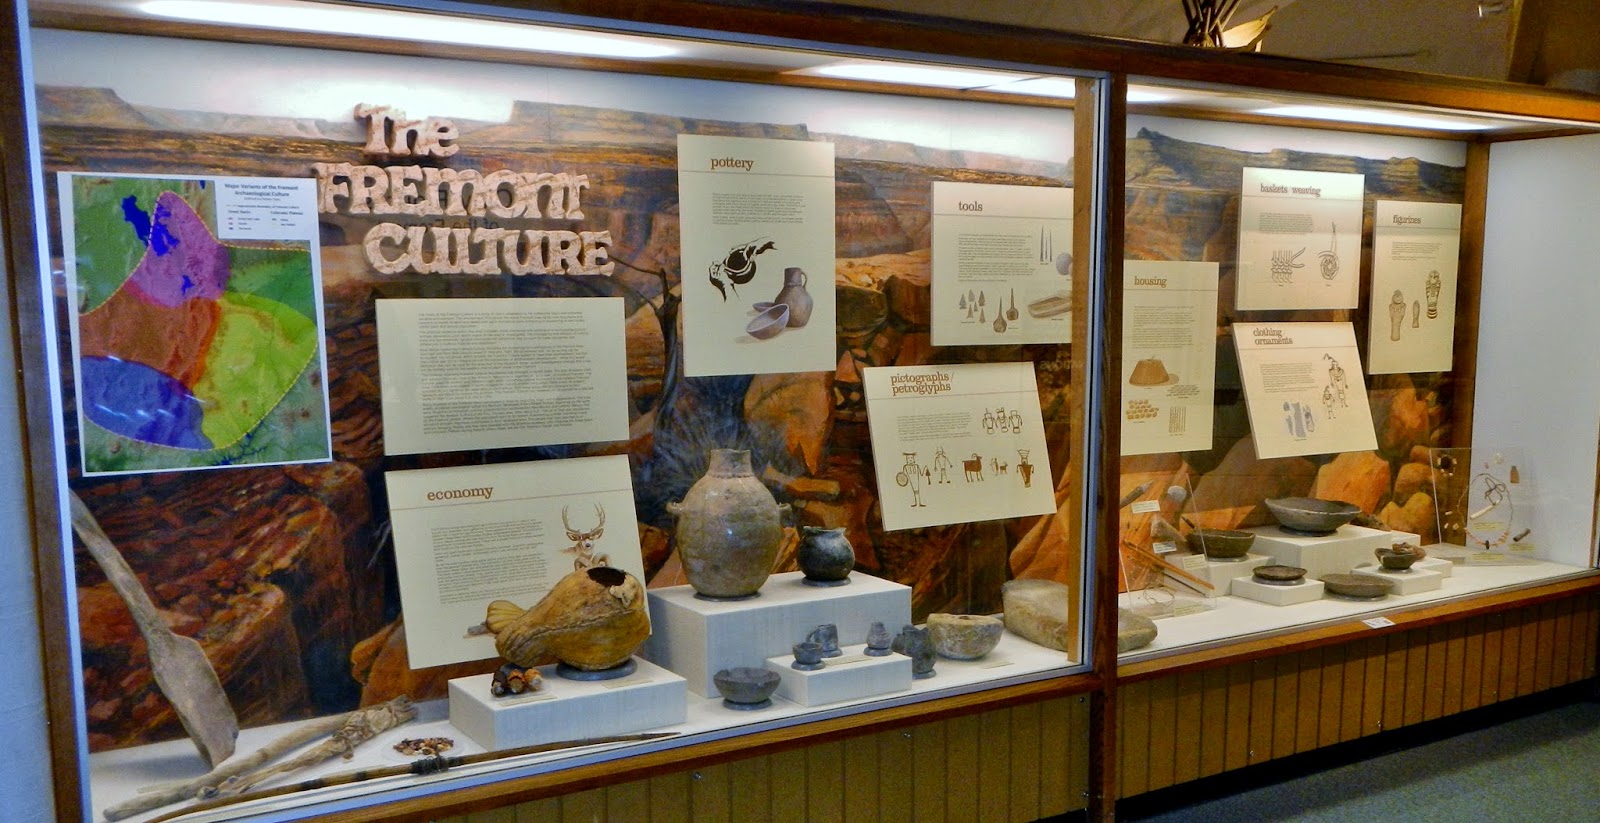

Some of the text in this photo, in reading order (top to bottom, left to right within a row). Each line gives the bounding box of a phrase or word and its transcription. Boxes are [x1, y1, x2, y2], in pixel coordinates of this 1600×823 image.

[354, 103, 460, 157] The
[711, 157, 754, 171] pottery
[1260, 183, 1321, 197] baskets weaving
[958, 201, 983, 212] tools
[1393, 214, 1422, 226] figurines
[1134, 276, 1167, 288] housing
[1253, 328, 1283, 338] clothing
[1254, 336, 1293, 345] ornaments
[891, 382, 952, 396] petroglyphs
[427, 486, 494, 500] economy
